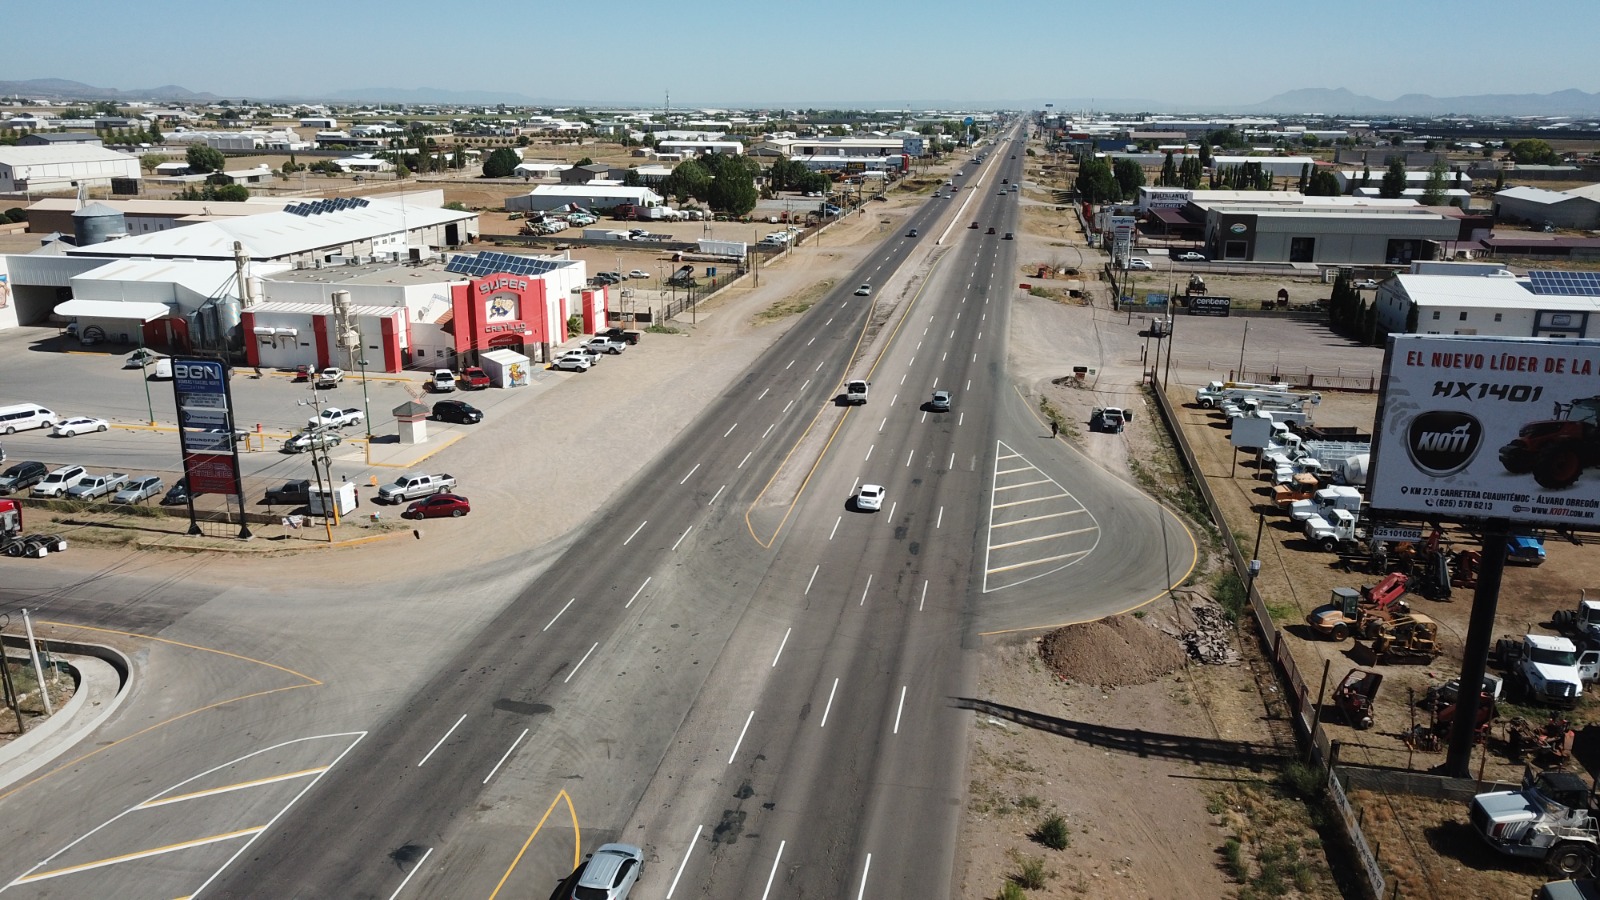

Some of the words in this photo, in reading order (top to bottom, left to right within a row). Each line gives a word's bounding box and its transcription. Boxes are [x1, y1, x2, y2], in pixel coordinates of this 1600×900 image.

[480, 278, 528, 294] SUPER
[485, 322, 526, 333] CASTILLO
[1406, 350, 1425, 367] EL
[1431, 352, 1485, 370] NUEVO
[1490, 352, 1539, 373] LÍDER
[1544, 357, 1566, 374] DE
[1571, 358, 1592, 376] LA
[174, 364, 220, 380] BGN
[1431, 381, 1544, 403] HX1401
[1416, 431, 1471, 453] KIOTI
[1410, 487, 1422, 495] KM
[1422, 488, 1439, 496] 27.5
[1440, 489, 1480, 499] CARRETERA
[1482, 491, 1530, 503] CUAUHTÉMOC
[1536, 494, 1564, 506] ÁLVARO
[1565, 498, 1600, 509] OBREGÓN
[1435, 498, 1456, 508] (625)
[1458, 500, 1472, 509] 578
[1473, 501, 1493, 511] 6213
[1531, 506, 1595, 519] WWW.KIOTI.COM.MX
